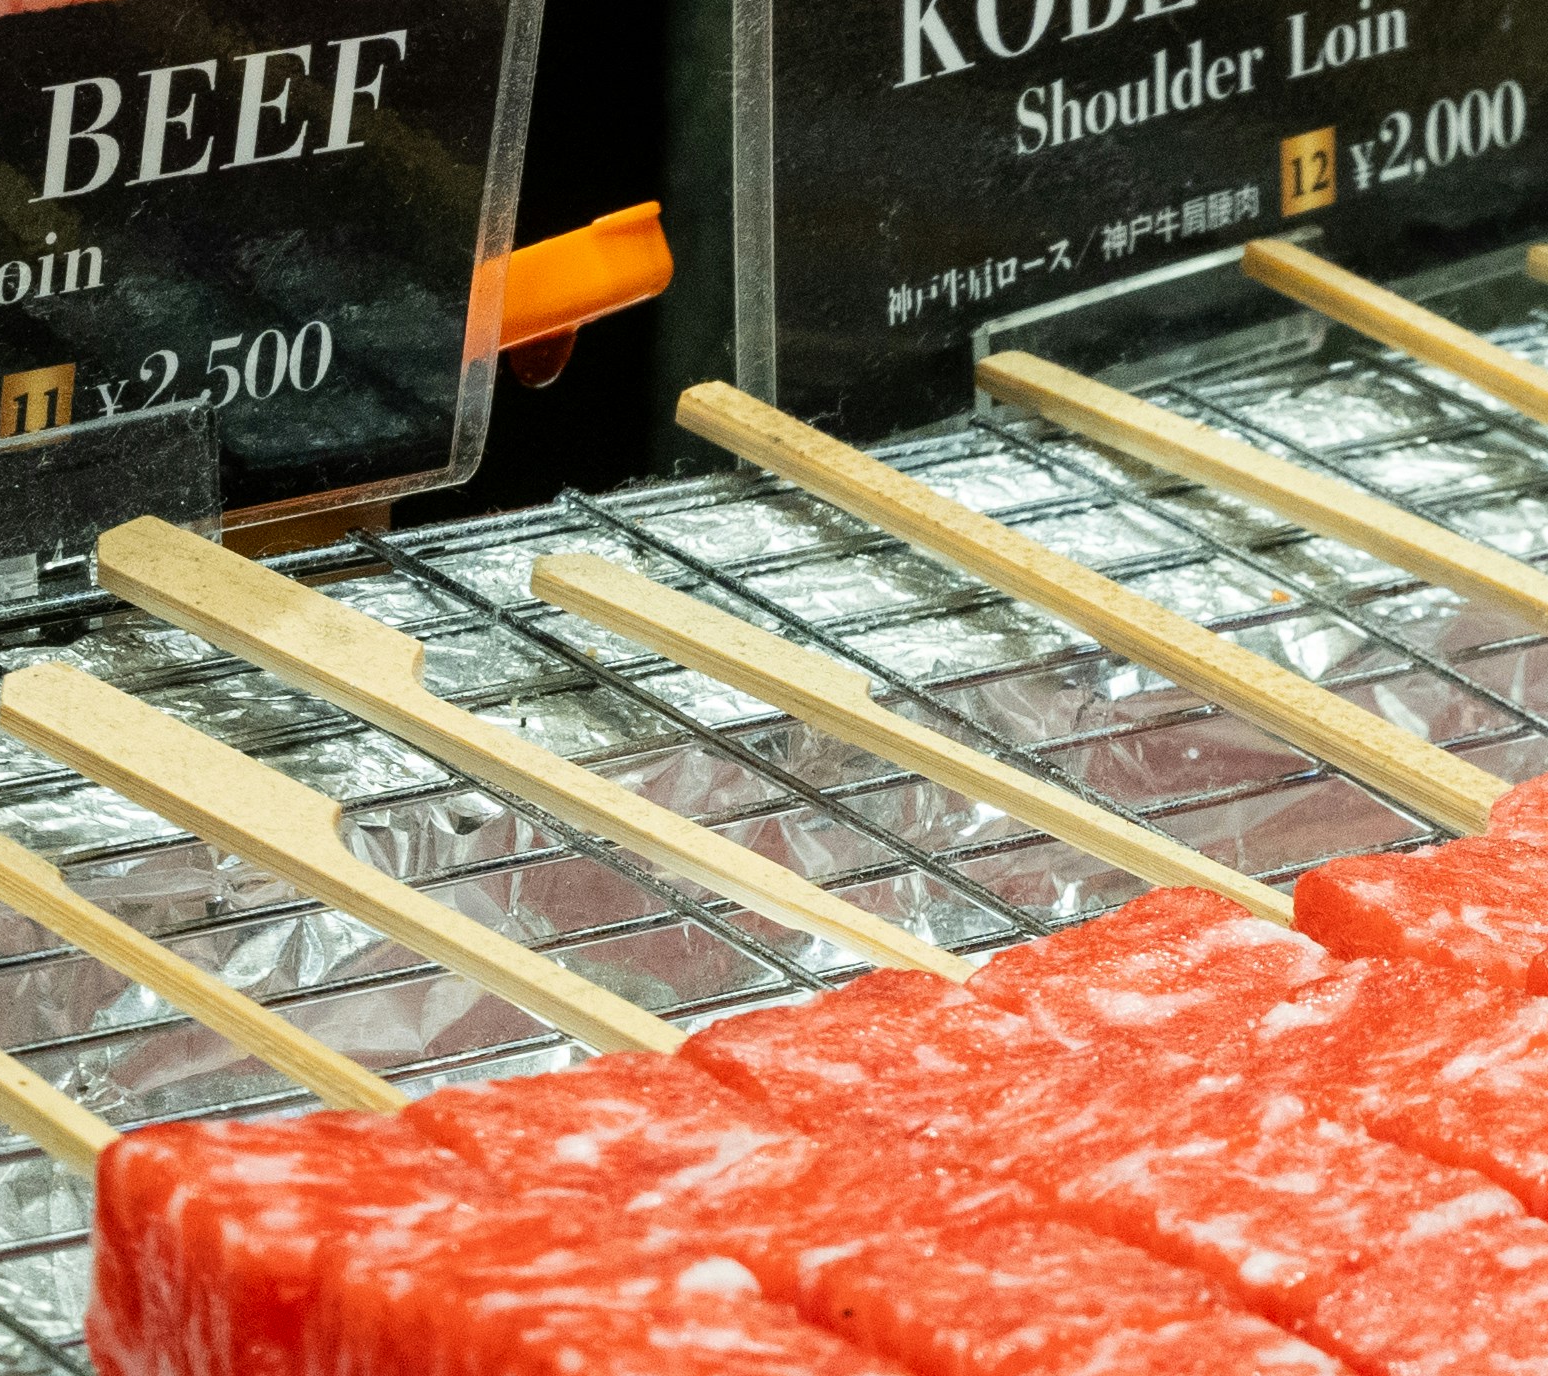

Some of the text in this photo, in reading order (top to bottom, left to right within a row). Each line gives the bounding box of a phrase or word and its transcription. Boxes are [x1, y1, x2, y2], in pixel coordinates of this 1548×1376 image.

[27, 29, 408, 204] BEEF
[1015, 40, 1265, 156] Shoulder
[1289, 80, 1527, 200] 12 ¥2,000
[11, 385, 61, 435] 11
